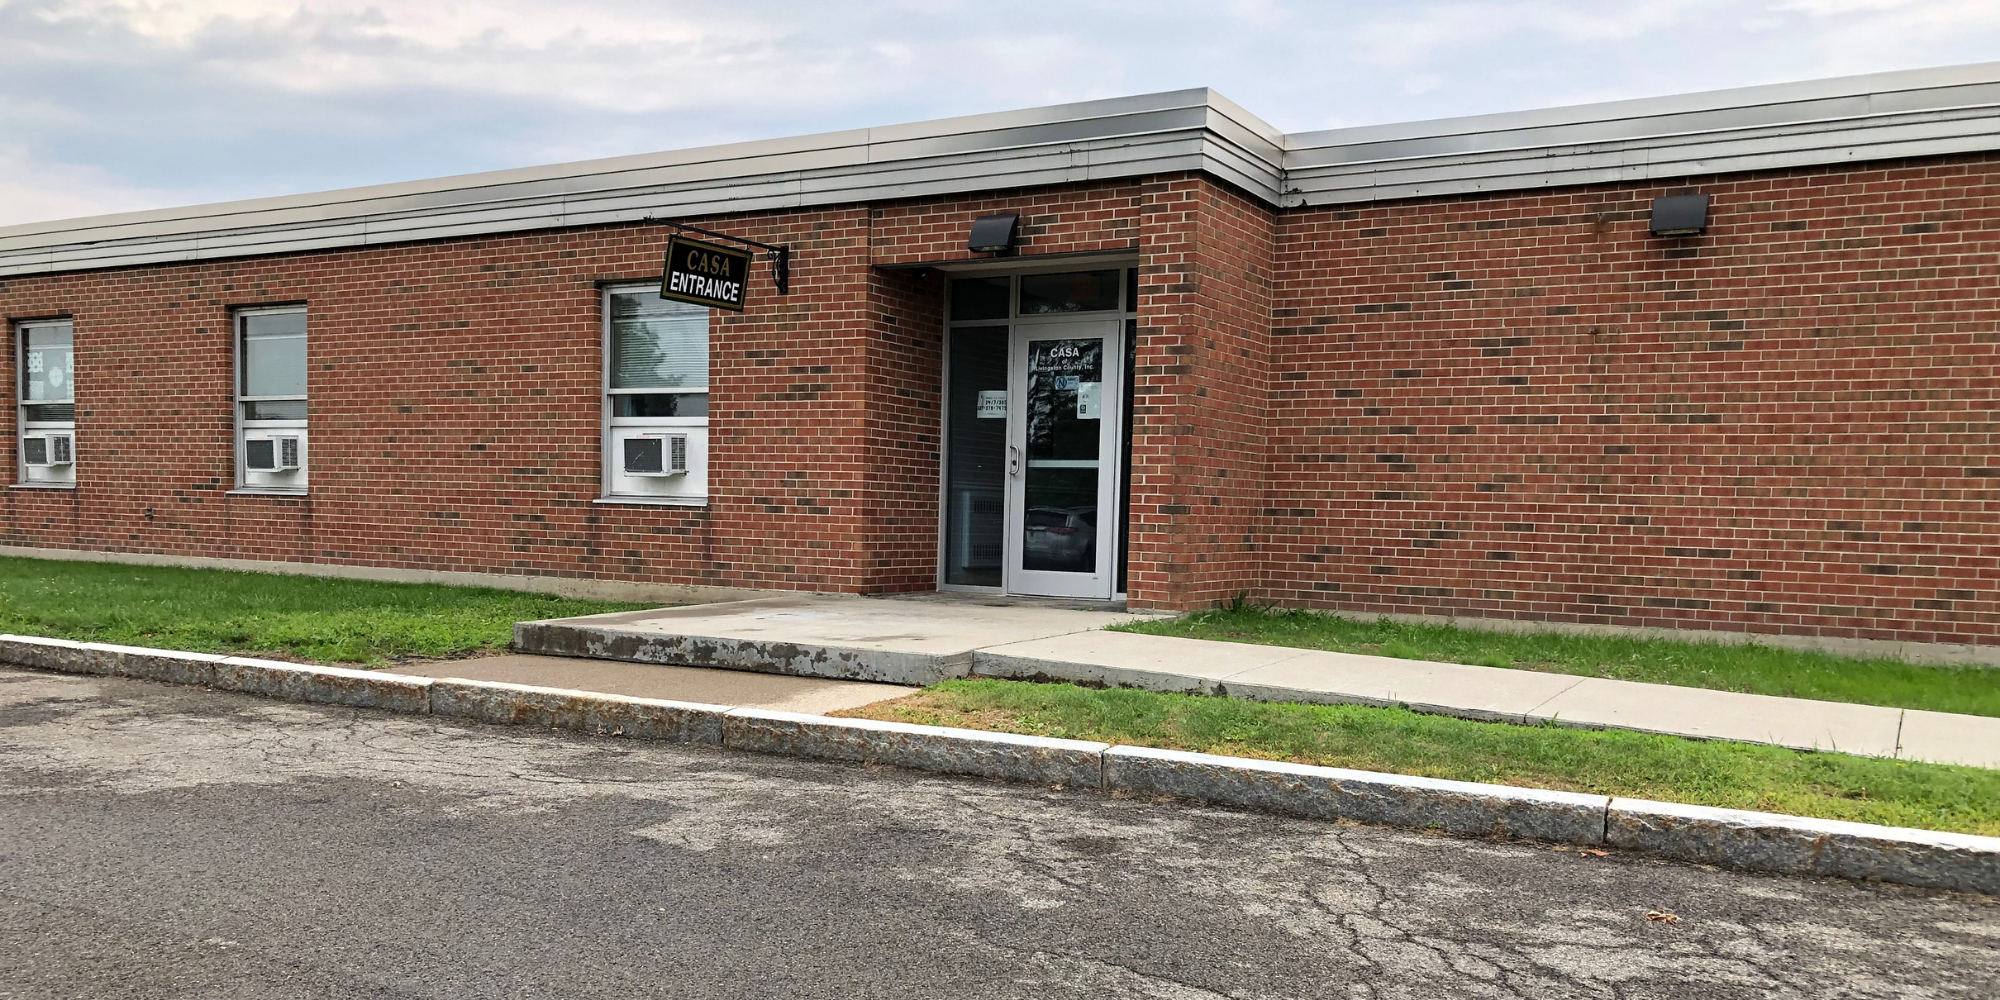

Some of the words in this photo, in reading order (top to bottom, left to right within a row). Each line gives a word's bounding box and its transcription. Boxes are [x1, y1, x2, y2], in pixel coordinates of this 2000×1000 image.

[687, 250, 730, 277] CASA
[670, 271, 740, 302] ENTRANCE
[1050, 347, 1080, 358] CASA
